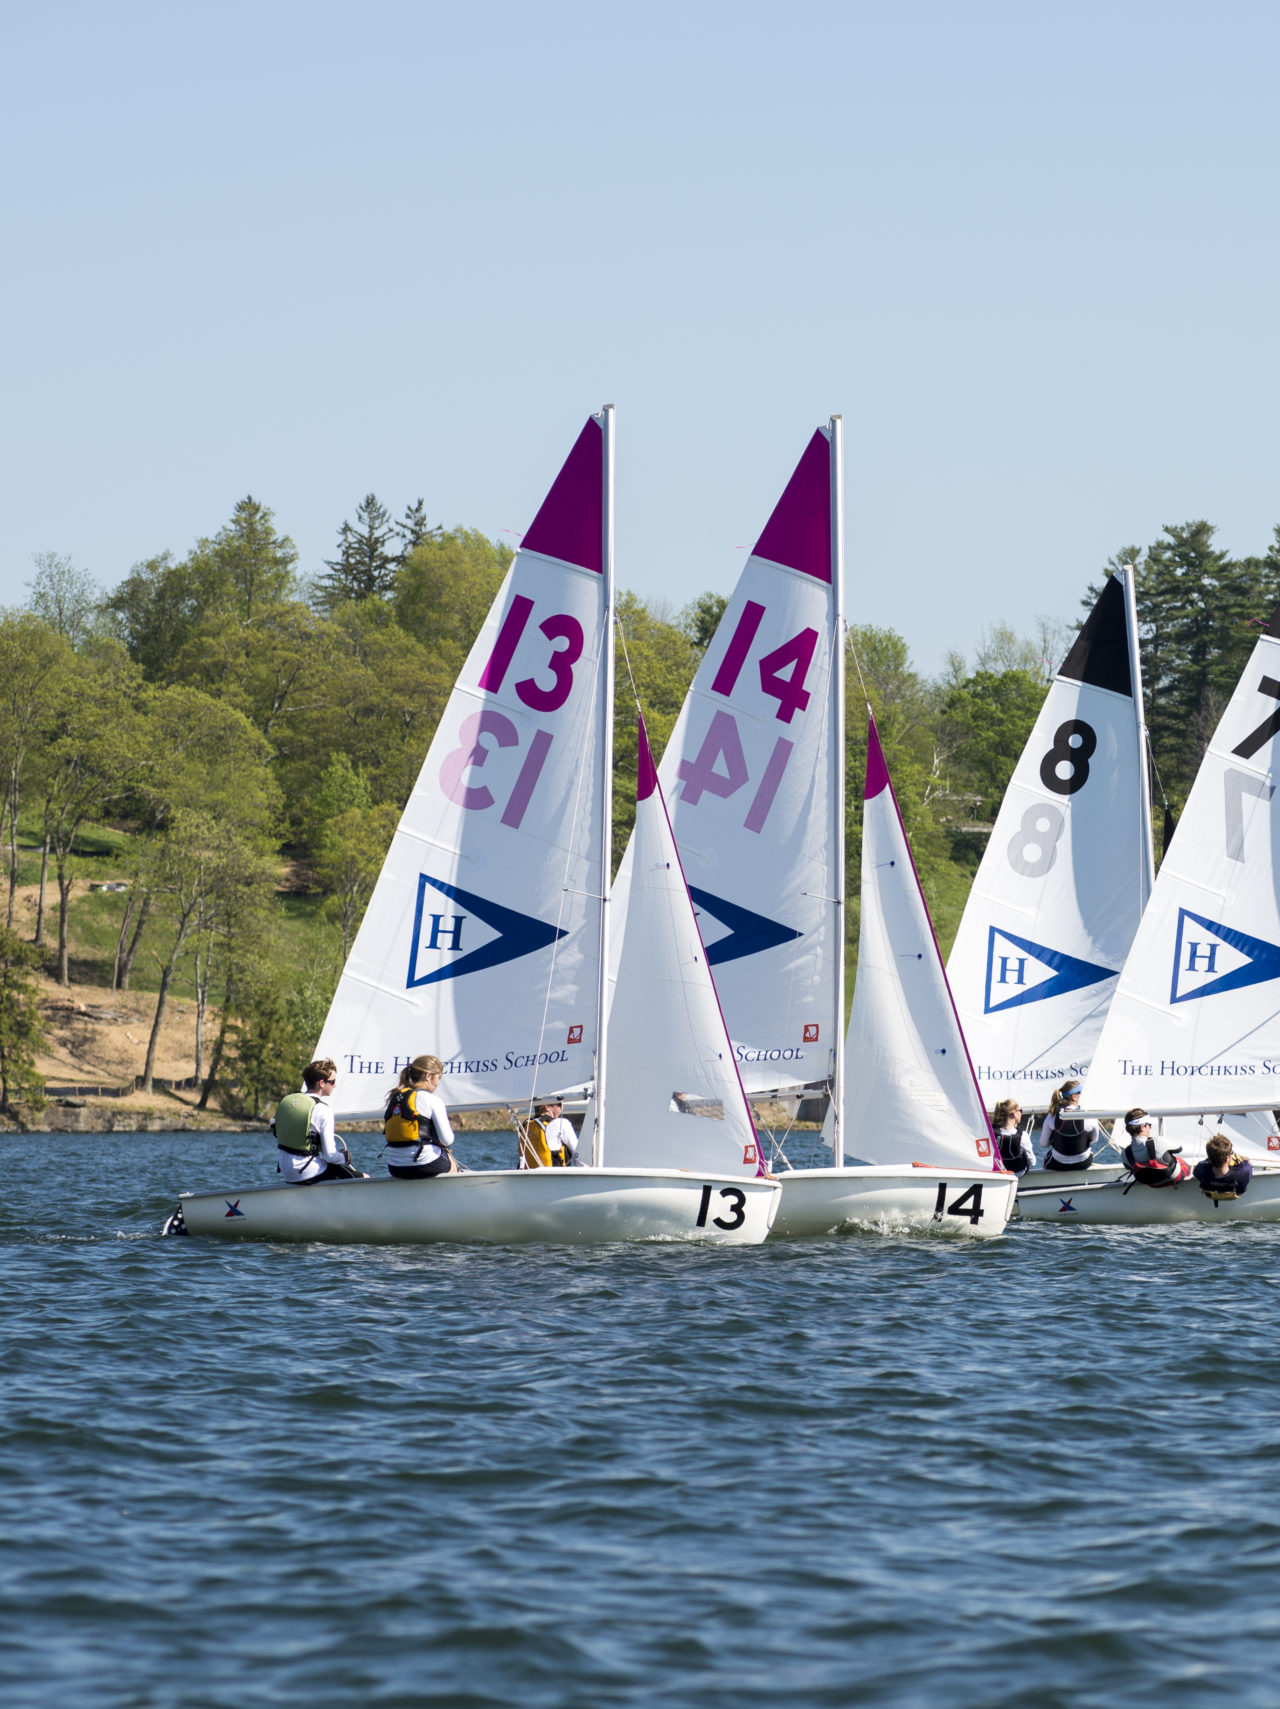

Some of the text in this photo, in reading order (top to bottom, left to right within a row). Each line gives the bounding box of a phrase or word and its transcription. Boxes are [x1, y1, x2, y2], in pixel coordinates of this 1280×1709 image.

[478, 594, 584, 712] 13
[711, 600, 819, 724] 14
[1040, 719, 1097, 795] 8
[425, 914, 467, 951] H
[997, 956, 1028, 985] H
[1185, 942, 1220, 973] H
[695, 1184, 747, 1231] 13
[933, 1182, 985, 1225] 14
